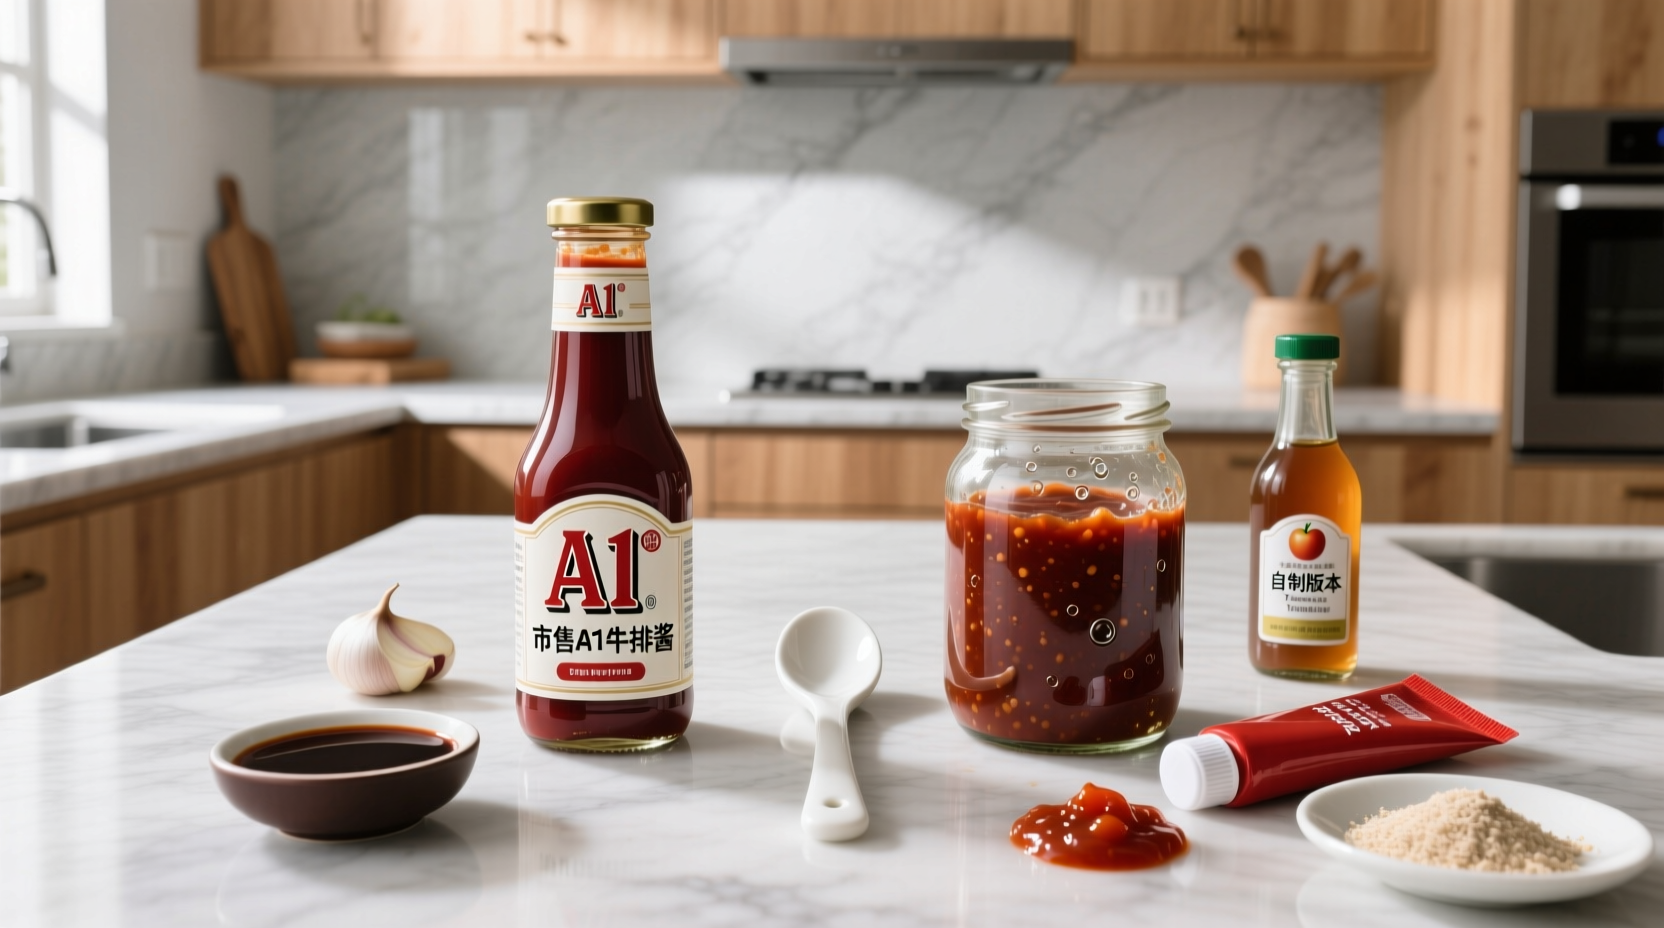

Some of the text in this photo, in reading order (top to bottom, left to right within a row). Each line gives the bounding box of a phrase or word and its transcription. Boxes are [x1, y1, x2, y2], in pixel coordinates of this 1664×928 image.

[576, 283, 617, 318] A1
[544, 528, 643, 614] A1
[1272, 571, 1342, 594] 自制版本
[532, 622, 674, 654] 市售A1牛排酱
